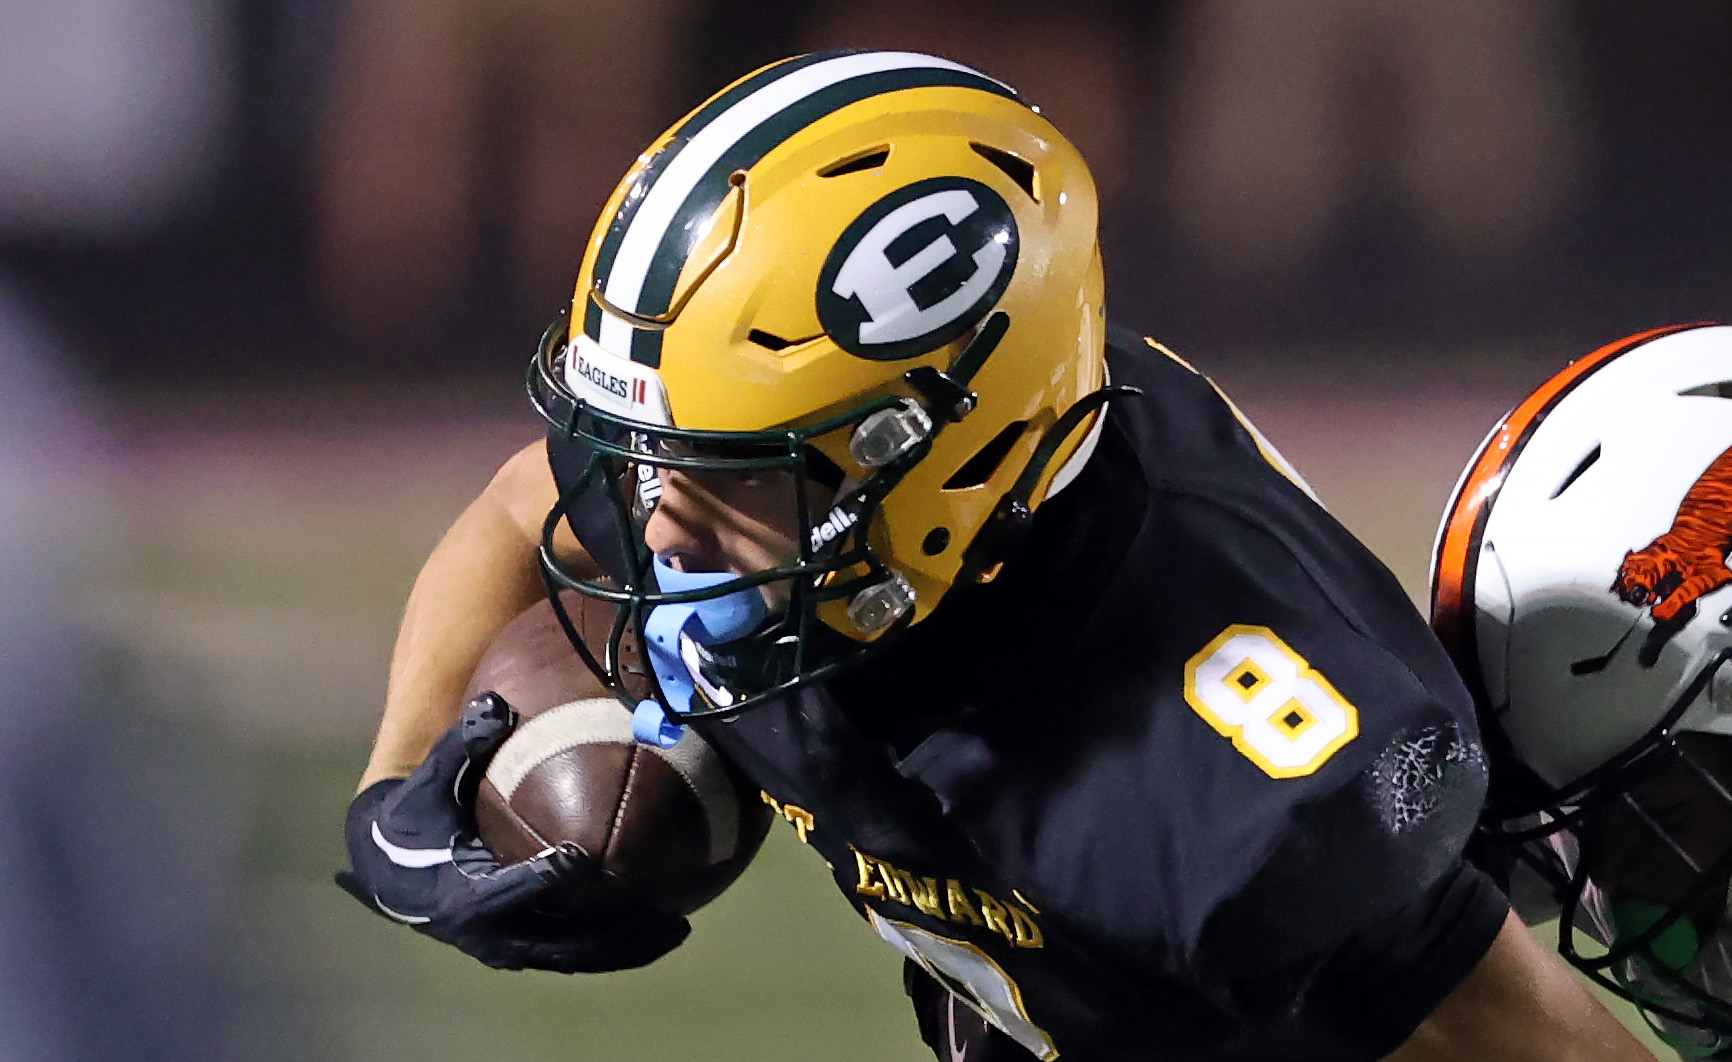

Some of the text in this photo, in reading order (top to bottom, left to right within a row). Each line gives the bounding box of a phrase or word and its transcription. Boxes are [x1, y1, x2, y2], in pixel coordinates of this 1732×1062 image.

[832, 189, 1008, 345] E
[577, 355, 628, 398] EAGLES
[1183, 623, 1361, 780] 8
[848, 843, 1044, 949] EDWARD
